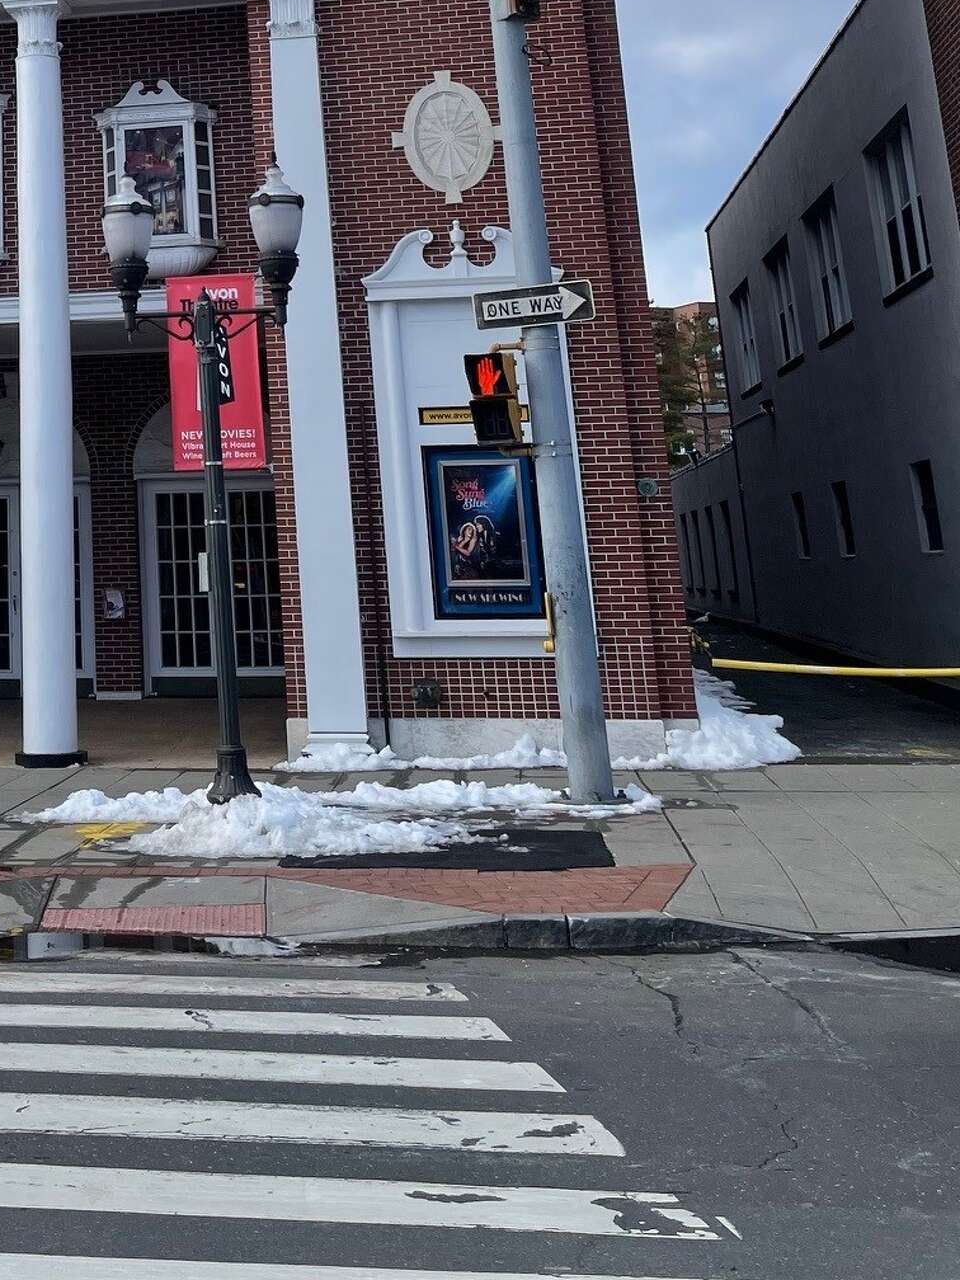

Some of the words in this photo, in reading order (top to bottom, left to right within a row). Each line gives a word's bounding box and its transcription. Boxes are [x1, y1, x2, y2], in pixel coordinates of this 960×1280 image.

[486, 301, 522, 318] ONE
[529, 295, 564, 312] WAY
[221, 429, 256, 439] OVIES!
[182, 443, 204, 451] Vibra
